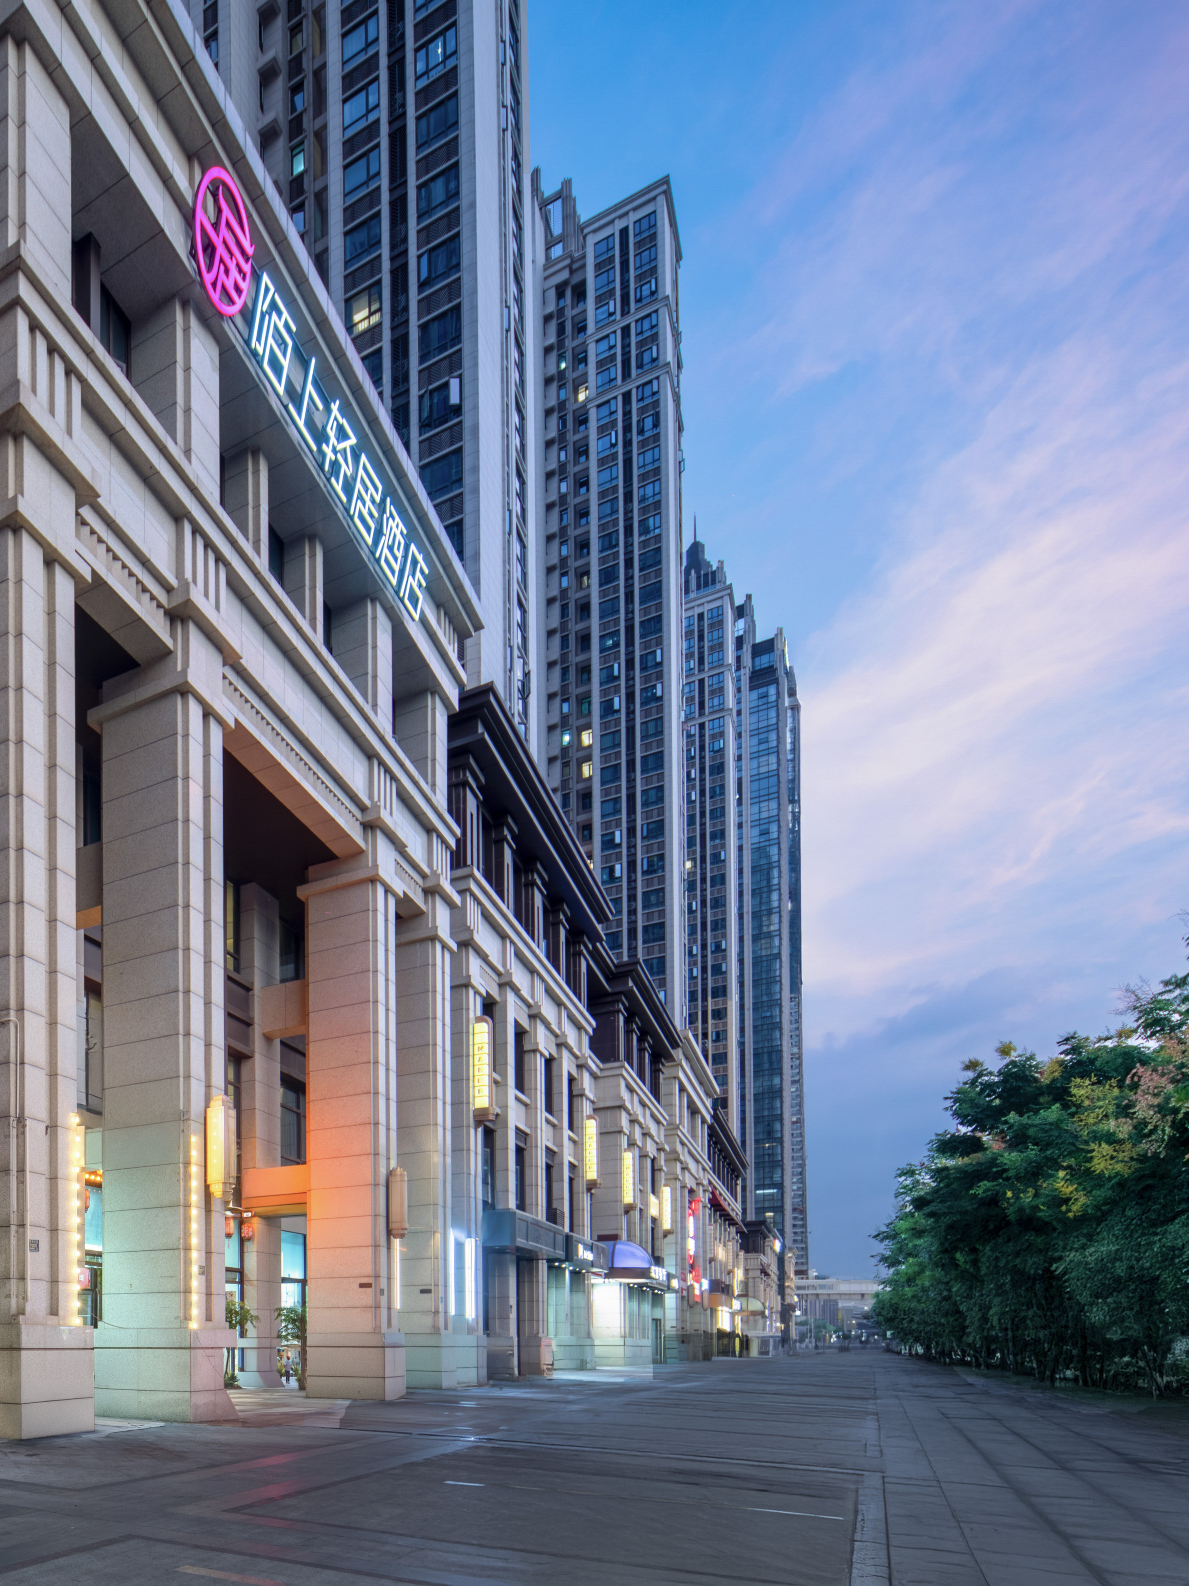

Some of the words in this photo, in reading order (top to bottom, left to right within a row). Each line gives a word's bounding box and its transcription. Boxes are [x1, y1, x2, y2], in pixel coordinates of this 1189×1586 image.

[250, 272, 429, 622] 陌上轻居酒店
